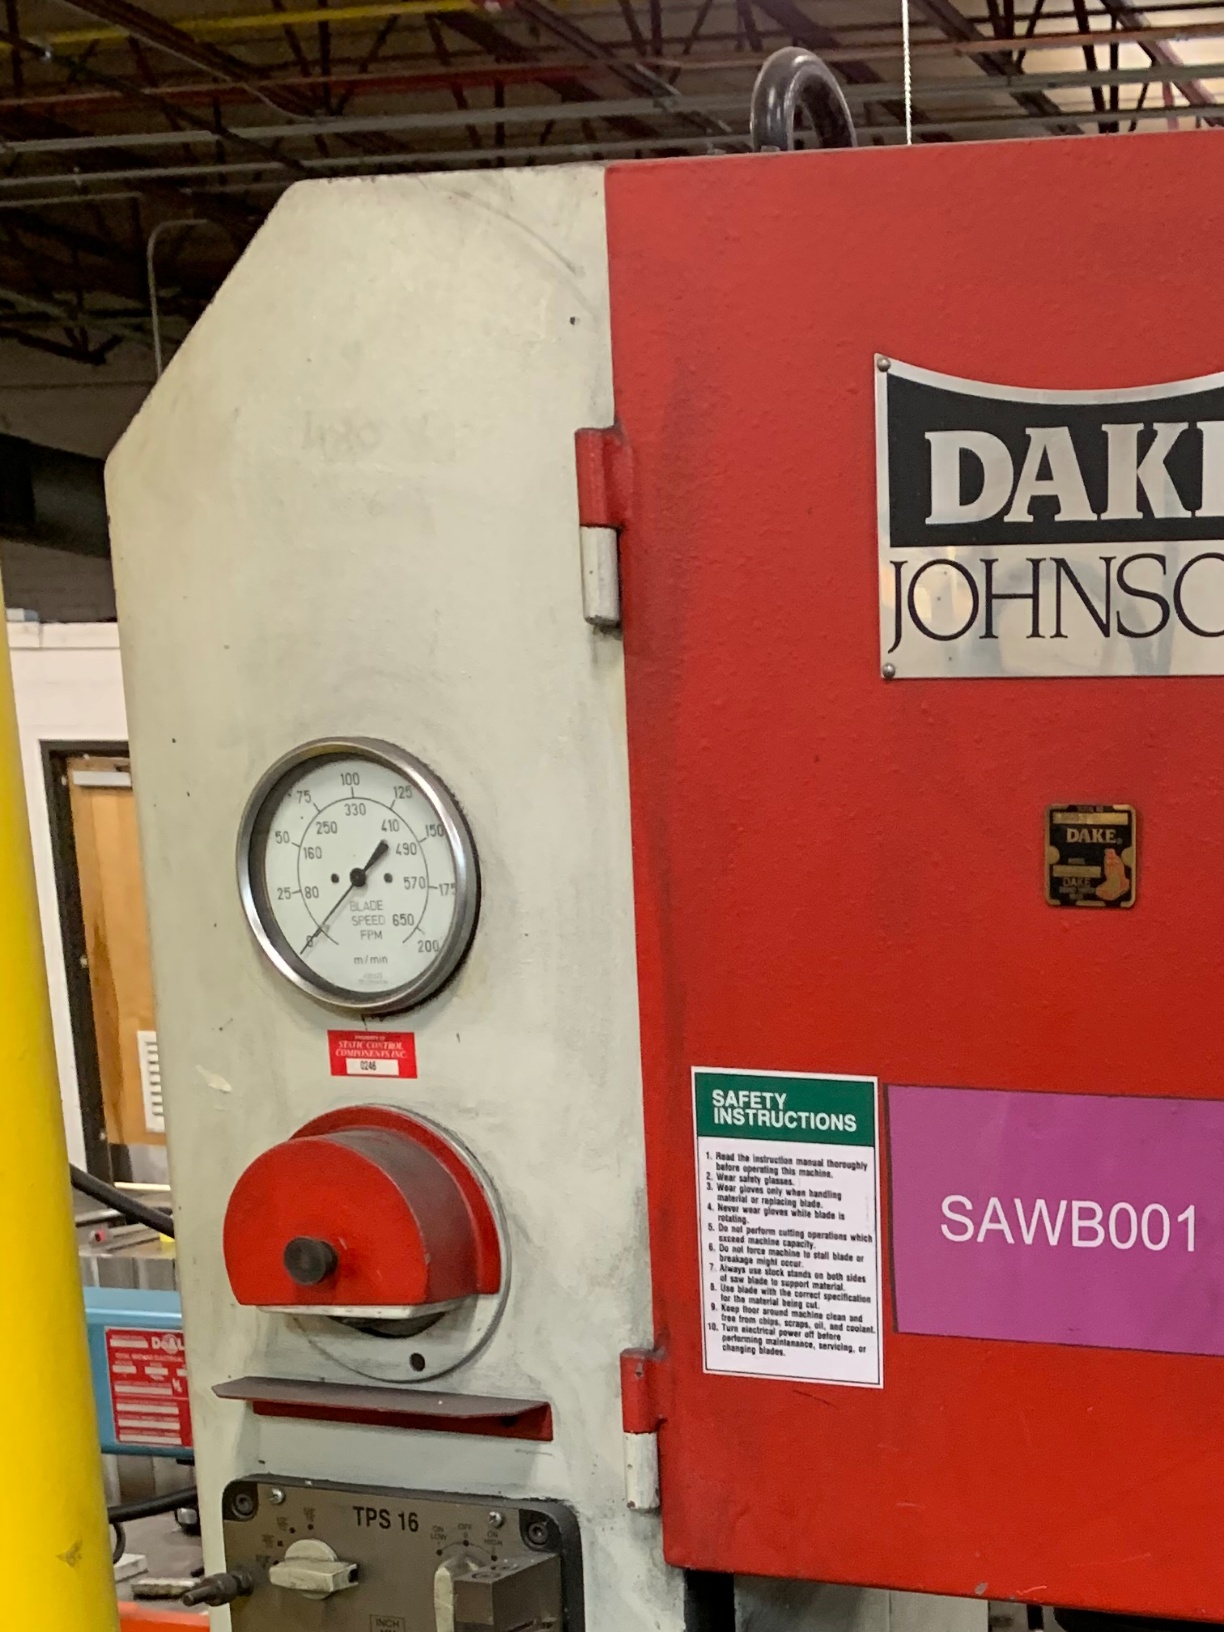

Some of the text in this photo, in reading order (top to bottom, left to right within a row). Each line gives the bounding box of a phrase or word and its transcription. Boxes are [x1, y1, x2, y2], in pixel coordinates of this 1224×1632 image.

[340, 772, 360, 786] 100
[297, 790, 312, 804] 75
[393, 785, 413, 799] 125
[344, 803, 366, 816] 330
[315, 820, 338, 835] 250
[381, 819, 400, 833] 410
[424, 824, 444, 838] 150
[275, 830, 290, 845] 50
[1066, 828, 1117, 844] DAKE
[303, 846, 323, 860] 160
[395, 842, 417, 856] 490
[403, 876, 426, 889] 570
[277, 886, 292, 900] 25
[304, 886, 320, 899] 80
[350, 900, 384, 911] BLADE
[351, 915, 386, 926] SPEED
[392, 913, 415, 927] 650
[360, 929, 383, 940] FPM
[417, 939, 440, 953] 200
[353, 954, 389, 965] m/min
[712, 1089, 787, 1110] SAFETY
[713, 1108, 857, 1132] INSTRUCTIONS
[706, 1151, 868, 1172] 1. Read the instruction manual thoroughly
[716, 1162, 833, 1178] before operating this machine.
[706, 1171, 795, 1186] 2. Wear safety glasses.
[706, 1182, 842, 1202] 3. Wear gloves only when handling
[717, 1194, 823, 1209] material or replacing blade.
[707, 1202, 845, 1220] 4. Never wear gloves while blade is
[718, 1214, 750, 1225] rotating.
[940, 1194, 1196, 1252] SAWB001
[707, 1222, 873, 1243] 5. Do not perform cutting operations which
[718, 1235, 816, 1249] exceed machine capacity.
[708, 1322, 841, 1341] 10. Turn electrical power off before
[722, 1343, 786, 1356] changing blades.
[352, 1505, 419, 1533] TPS 16
[375, 1618, 400, 1628] INCH
